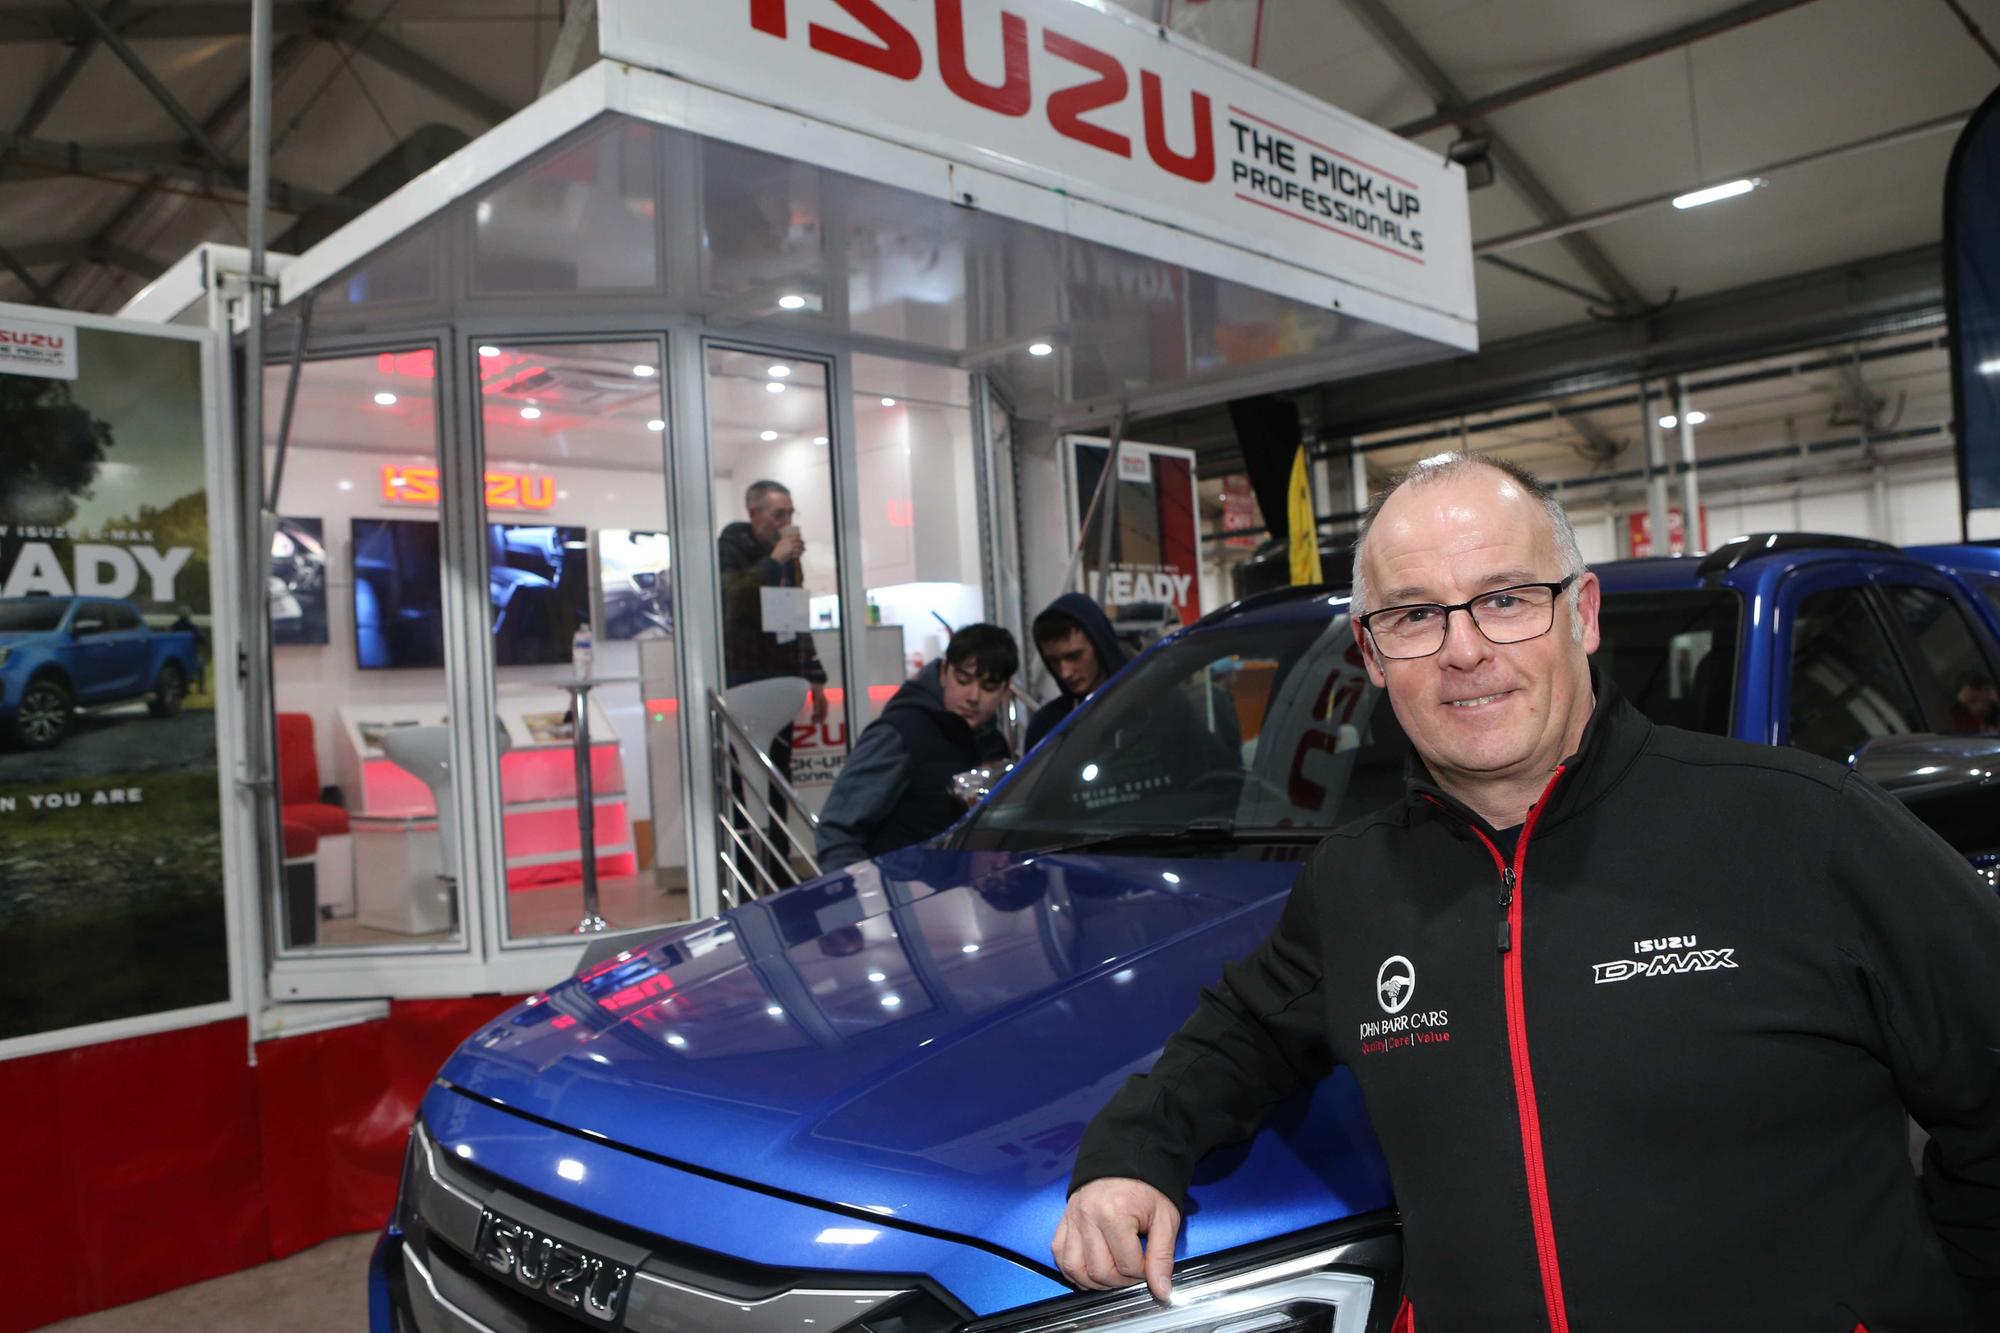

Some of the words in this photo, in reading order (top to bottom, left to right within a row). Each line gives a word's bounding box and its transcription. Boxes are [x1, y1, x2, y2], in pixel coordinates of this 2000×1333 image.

[1229, 119, 1297, 174] THE
[1310, 154, 1420, 219] PICK-UP
[1231, 160, 1424, 252] PROFESSIONALS
[383, 465, 555, 509] ISZU
[28, 792, 81, 810] YOU
[92, 787, 143, 804] ARE
[1633, 934, 1697, 954] ISUZU
[1360, 1021, 1380, 1040] JOHN
[1381, 1015, 1409, 1034] BARR
[1410, 1010, 1448, 1029] CARS
[1416, 1030, 1450, 1043] Value
[475, 1210, 628, 1321] ISUZU
